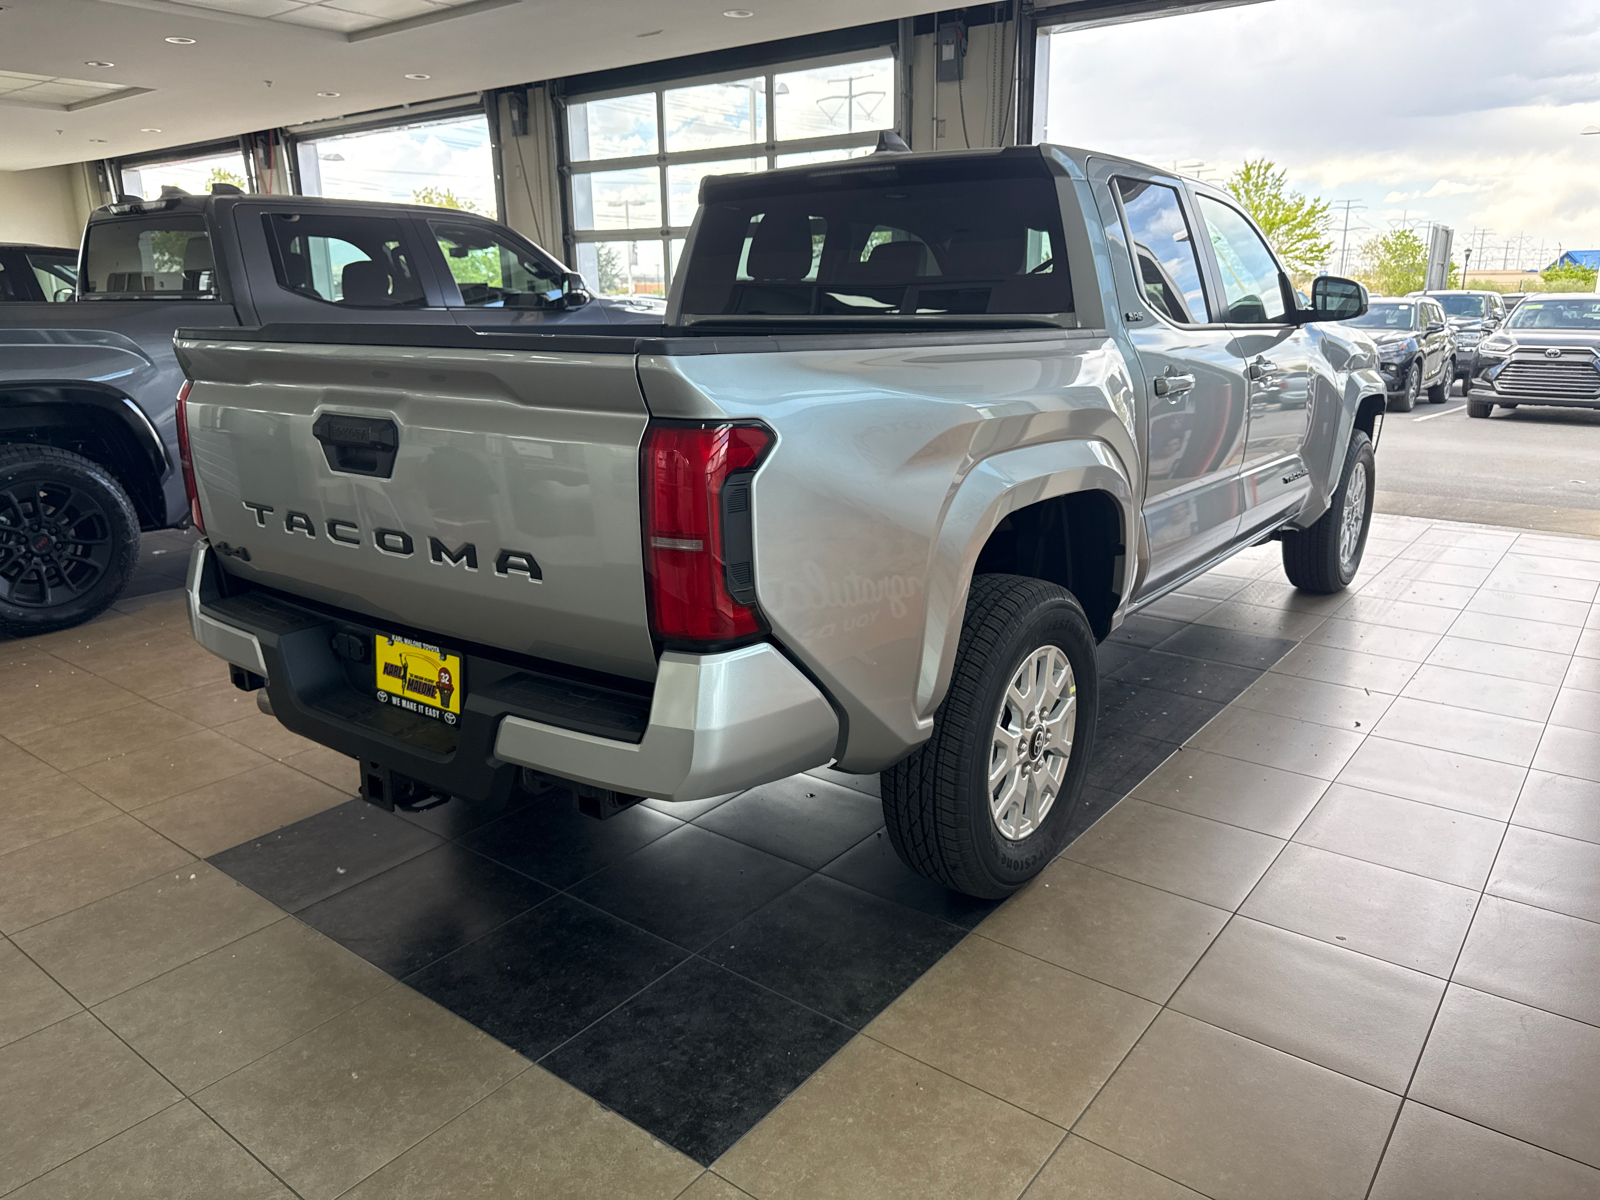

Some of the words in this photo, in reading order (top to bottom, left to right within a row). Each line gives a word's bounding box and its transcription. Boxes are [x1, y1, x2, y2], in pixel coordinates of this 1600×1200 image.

[331, 427, 367, 440] TOYOTA
[242, 500, 543, 584] TACOMA
[392, 635, 403, 644] KARL
[403, 638, 422, 649] MALONE
[423, 643, 440, 653] TOYOTA
[383, 662, 403, 680] KARL
[440, 672, 450, 685] 32
[406, 678, 437, 699] MALONE
[392, 696, 401, 706] WE
[401, 699, 417, 712] MAKE
[418, 704, 424, 714] IT
[425, 706, 440, 719] EASY
